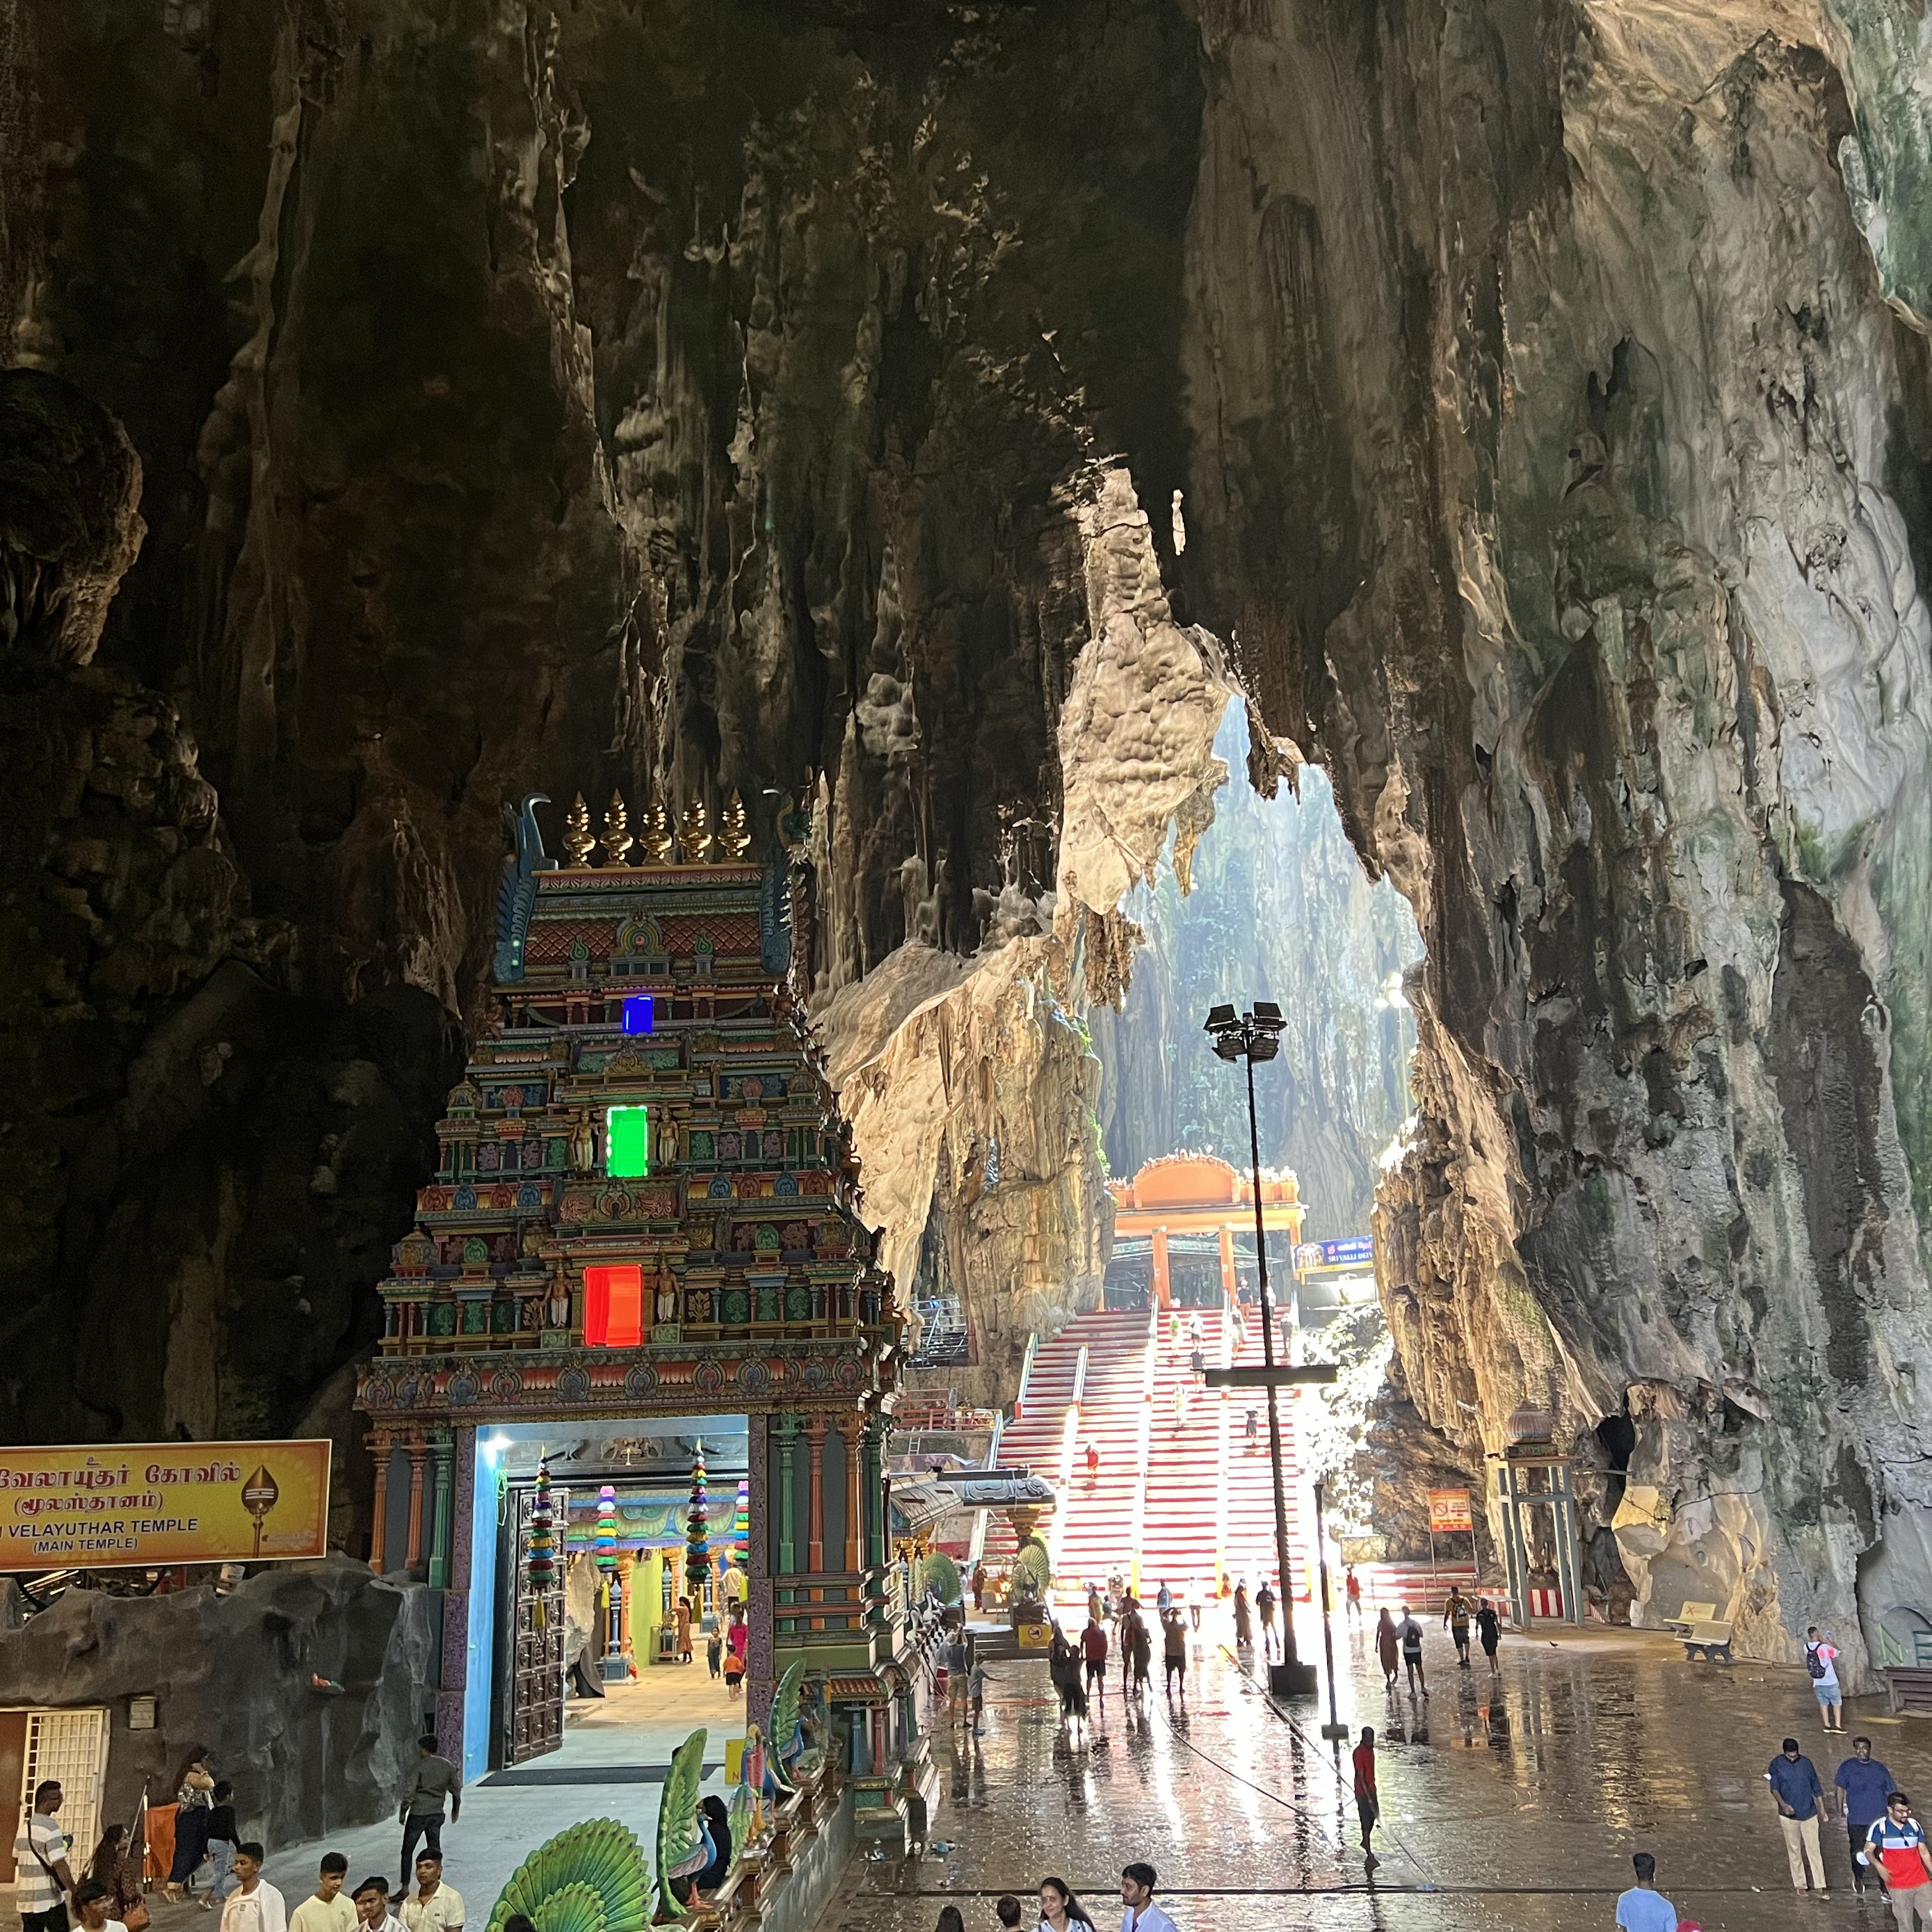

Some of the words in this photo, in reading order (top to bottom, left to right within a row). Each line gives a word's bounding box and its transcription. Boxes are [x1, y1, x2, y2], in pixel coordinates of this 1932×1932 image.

[145, 1461, 241, 1484] கோவில்
[8, 1521, 125, 1538] VELAYUTHAR
[130, 1518, 199, 1533] TEMPLE
[33, 1540, 73, 1553] (MAIN
[78, 1538, 138, 1550] TEMPLE)
